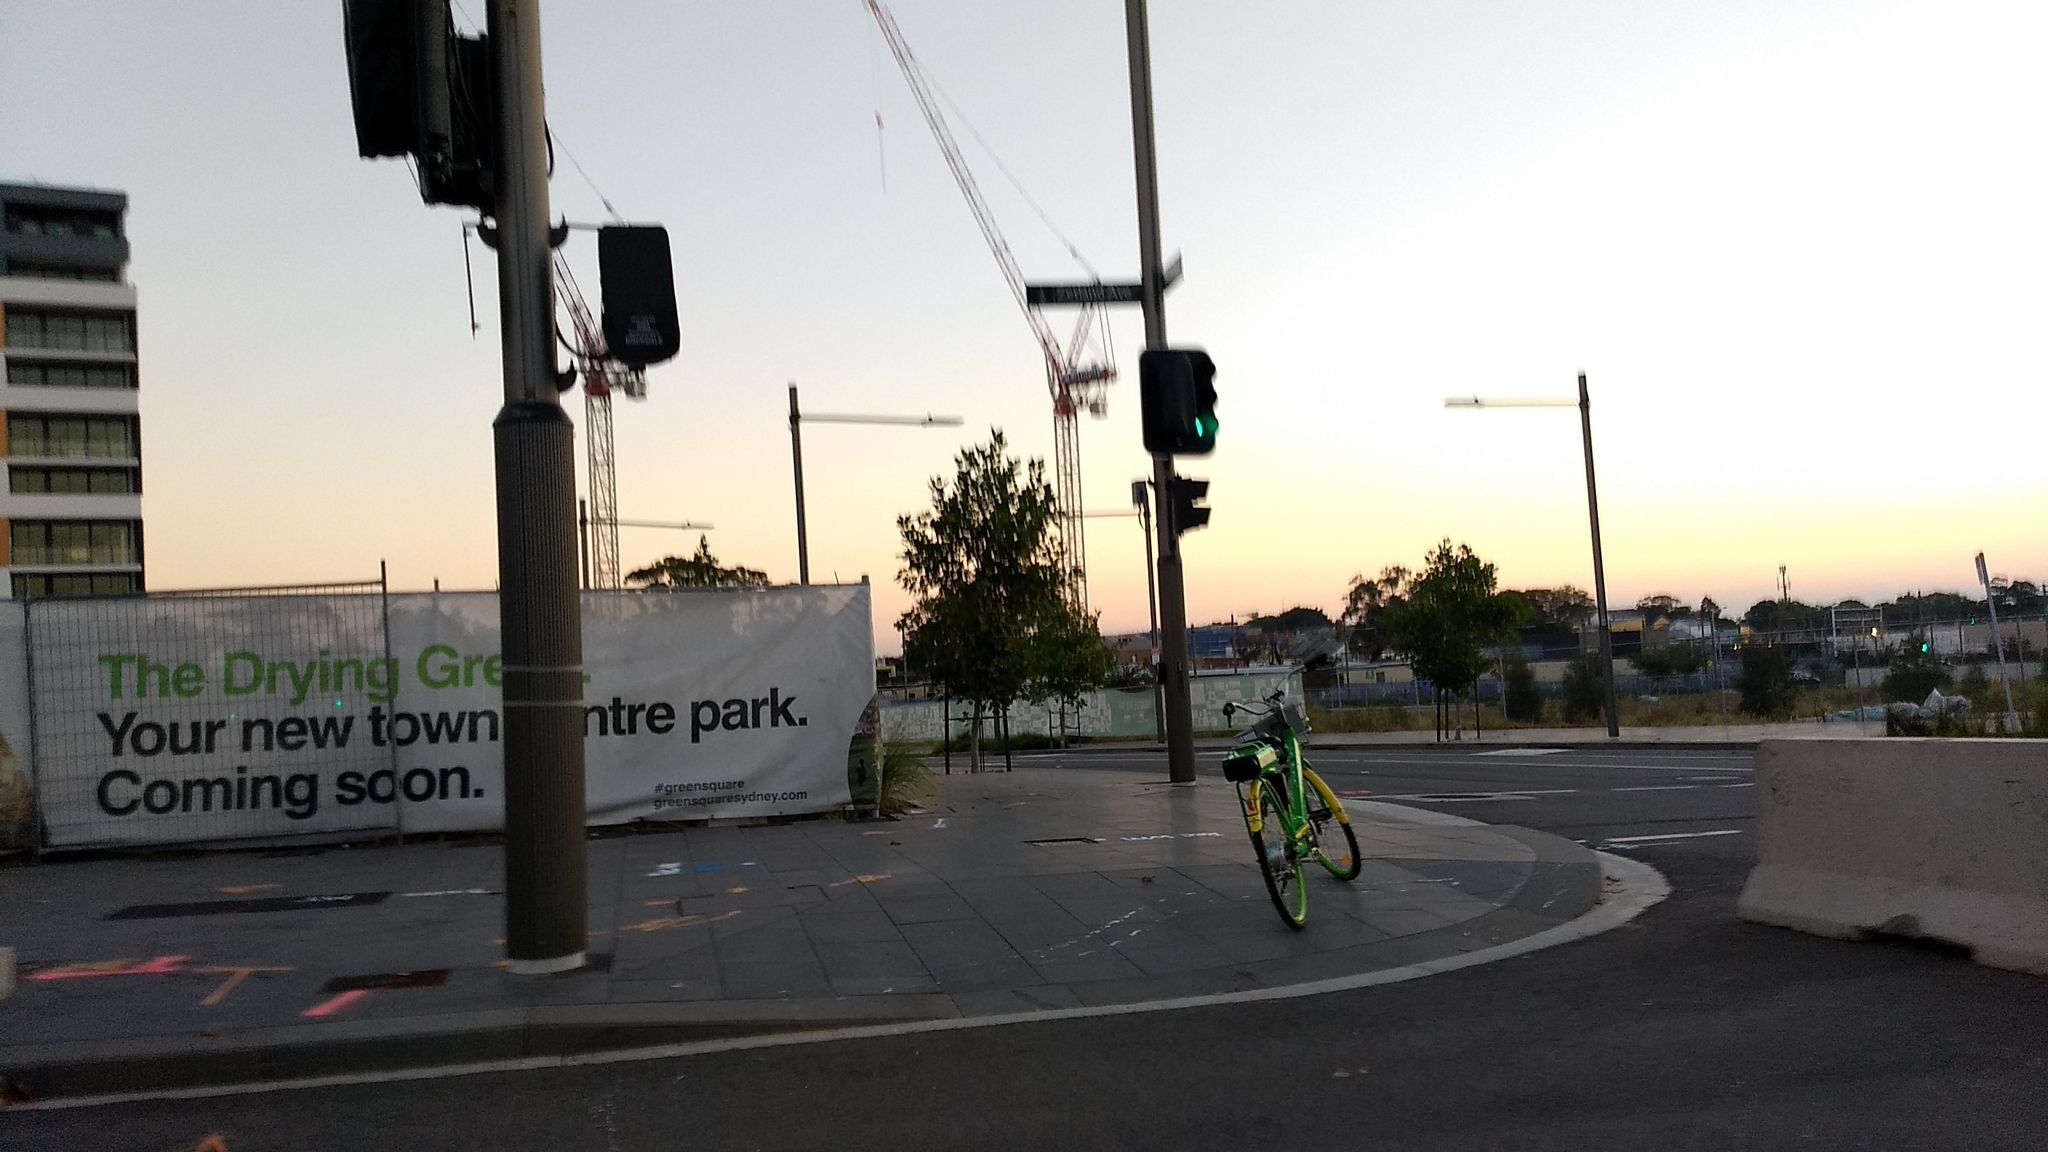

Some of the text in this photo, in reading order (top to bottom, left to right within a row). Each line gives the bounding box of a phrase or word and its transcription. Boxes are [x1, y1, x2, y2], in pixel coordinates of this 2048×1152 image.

[98, 652, 206, 700] The
[223, 649, 399, 706] Drying
[97, 687, 809, 758] Your new town ntre park.
[97, 764, 485, 820] Coming soon.
[653, 790, 808, 810] greensquaresydney.com
[654, 779, 745, 796] #greensquare
